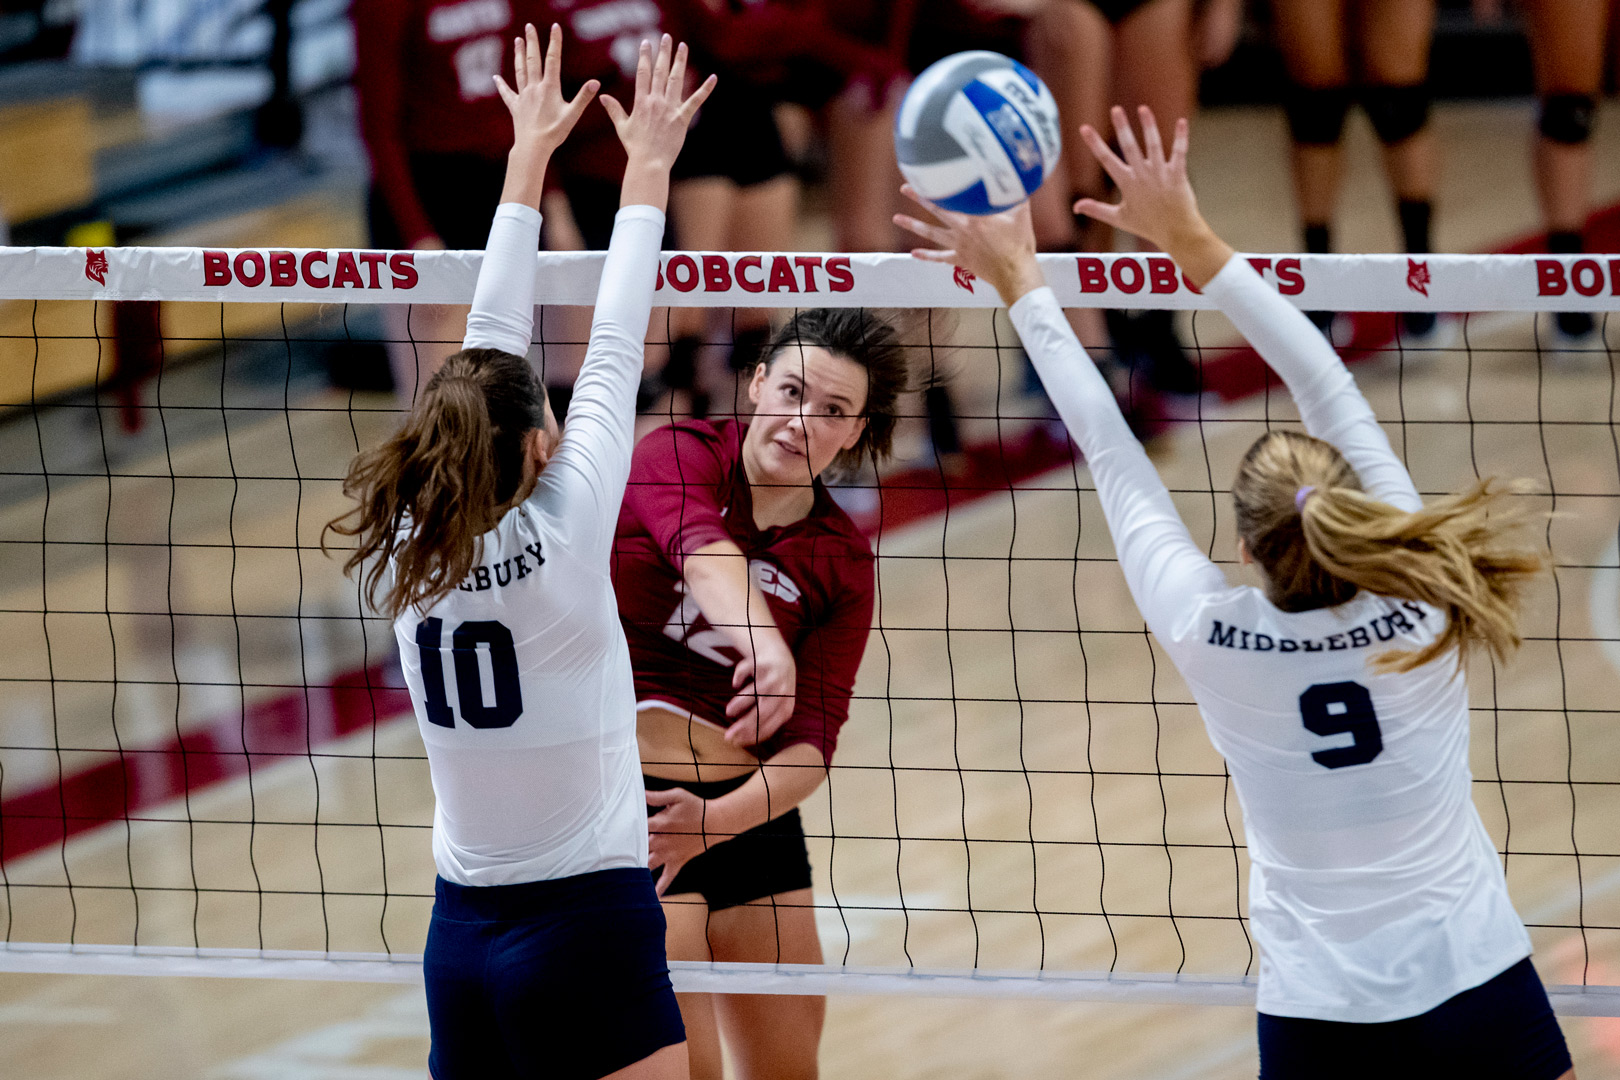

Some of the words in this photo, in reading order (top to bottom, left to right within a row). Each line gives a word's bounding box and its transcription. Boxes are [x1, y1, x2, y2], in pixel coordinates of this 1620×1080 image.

[202, 250, 419, 290] BOBCATS
[1075, 256, 1306, 296] BOBS
[1207, 601, 1427, 652] MIDDLEBURY
[415, 616, 524, 730] 10
[1297, 680, 1384, 770] 9
